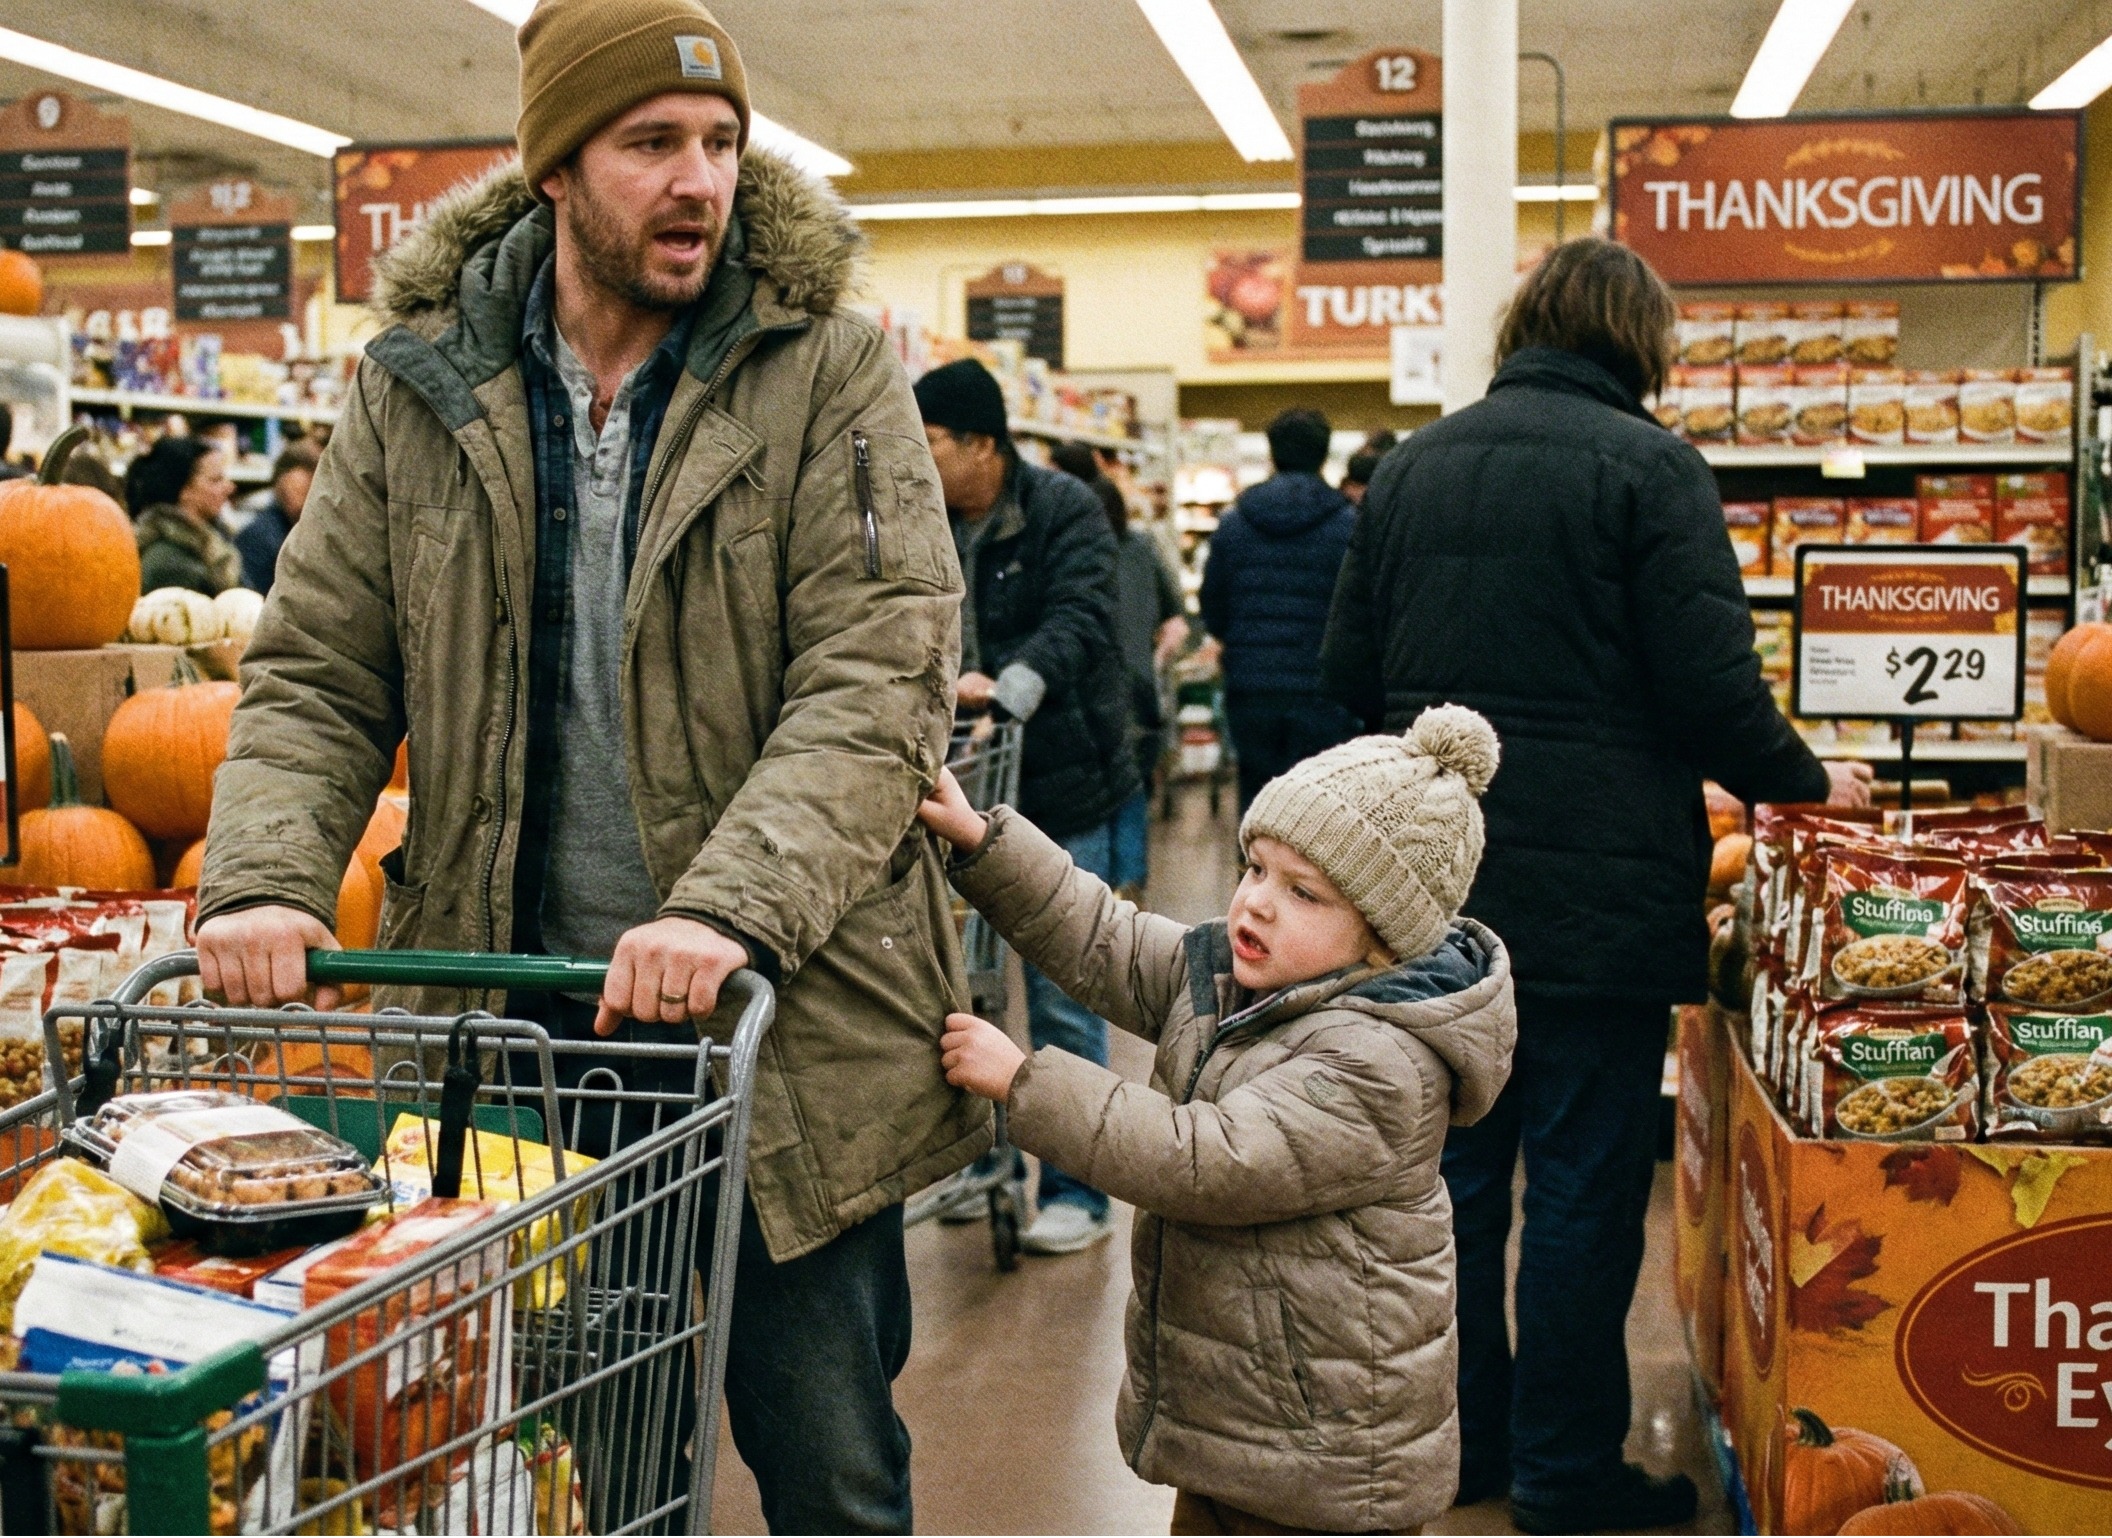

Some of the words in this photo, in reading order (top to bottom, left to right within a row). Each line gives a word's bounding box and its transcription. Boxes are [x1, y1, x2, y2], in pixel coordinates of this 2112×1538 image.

[1375, 56, 1416, 90] 12
[1643, 173, 2044, 231] THANKSGIVING
[1819, 585, 2000, 612] THANKSGIVING
